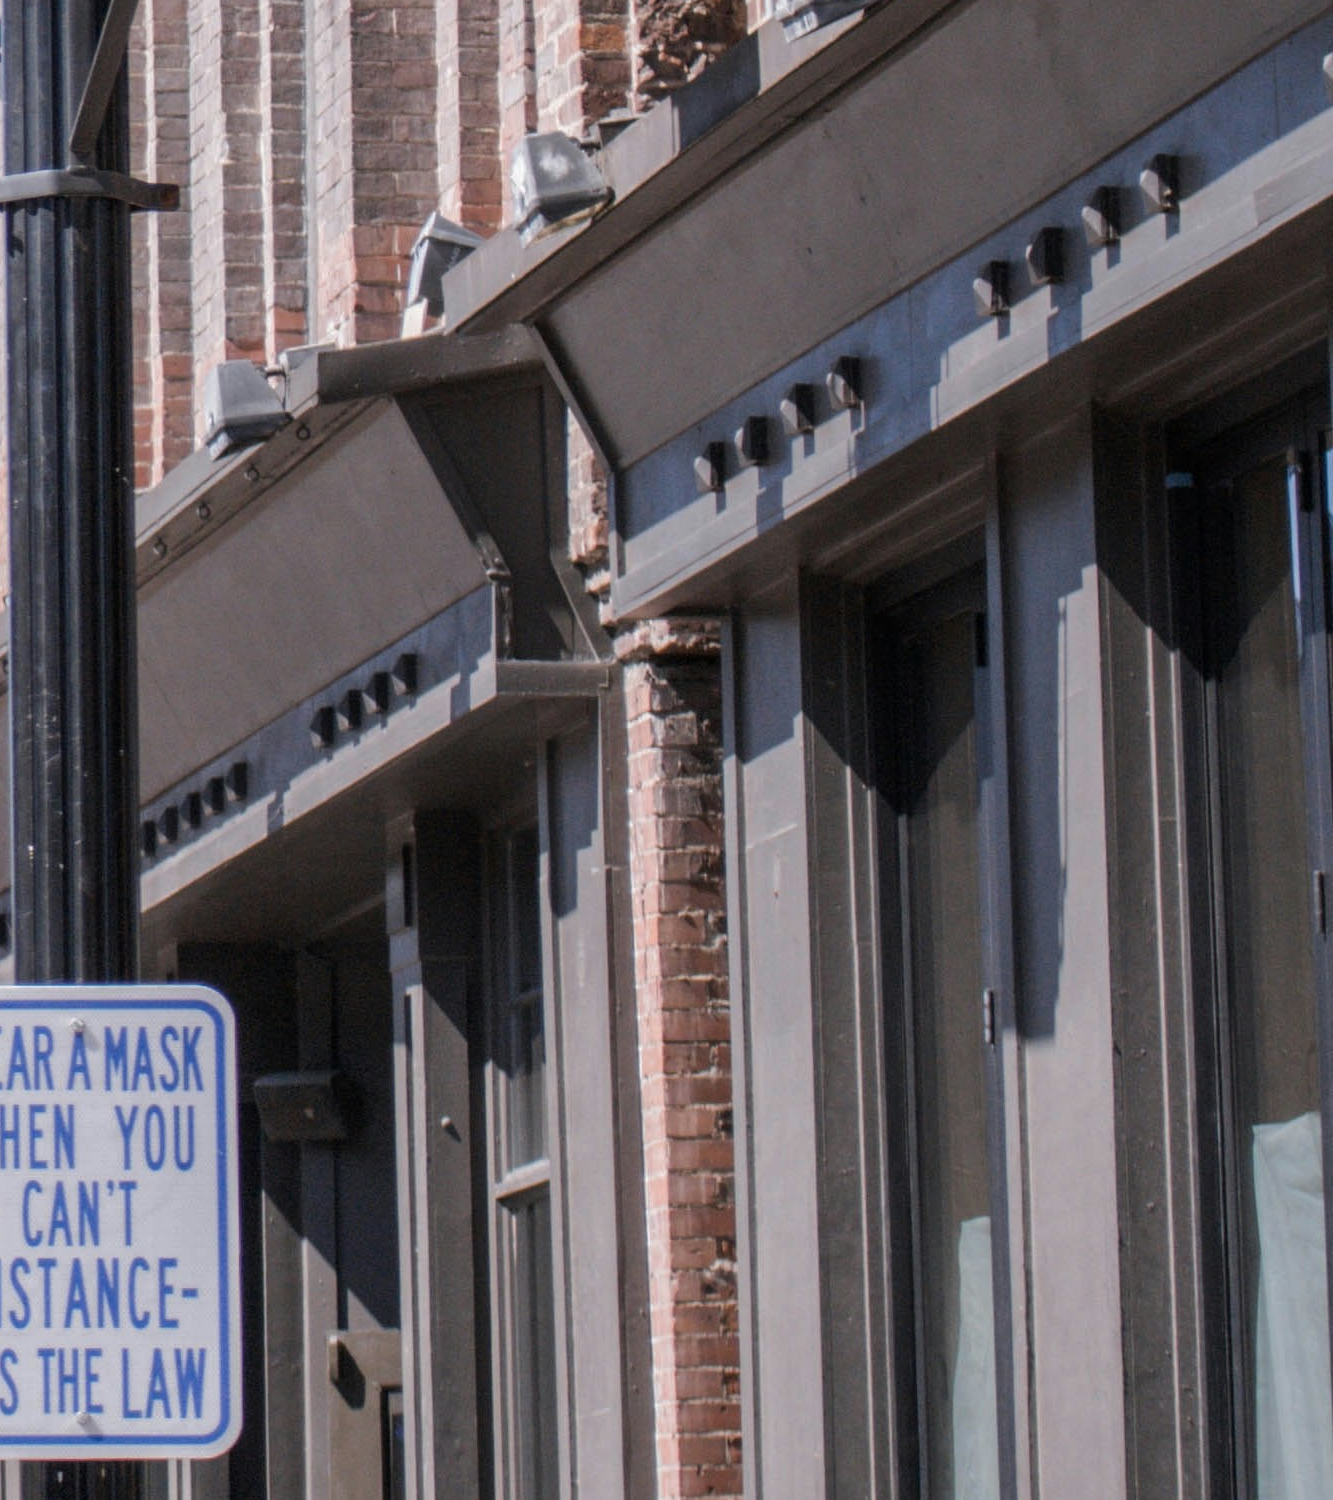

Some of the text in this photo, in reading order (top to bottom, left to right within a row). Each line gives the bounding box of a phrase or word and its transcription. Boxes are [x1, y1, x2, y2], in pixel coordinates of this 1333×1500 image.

[65, 1028, 92, 1092] A
[103, 1024, 205, 1093] MASK
[115, 1104, 196, 1172] YOU
[21, 1179, 139, 1248] CAN'T
[36, 1347, 105, 1415] THE
[121, 1346, 208, 1420] LAW
